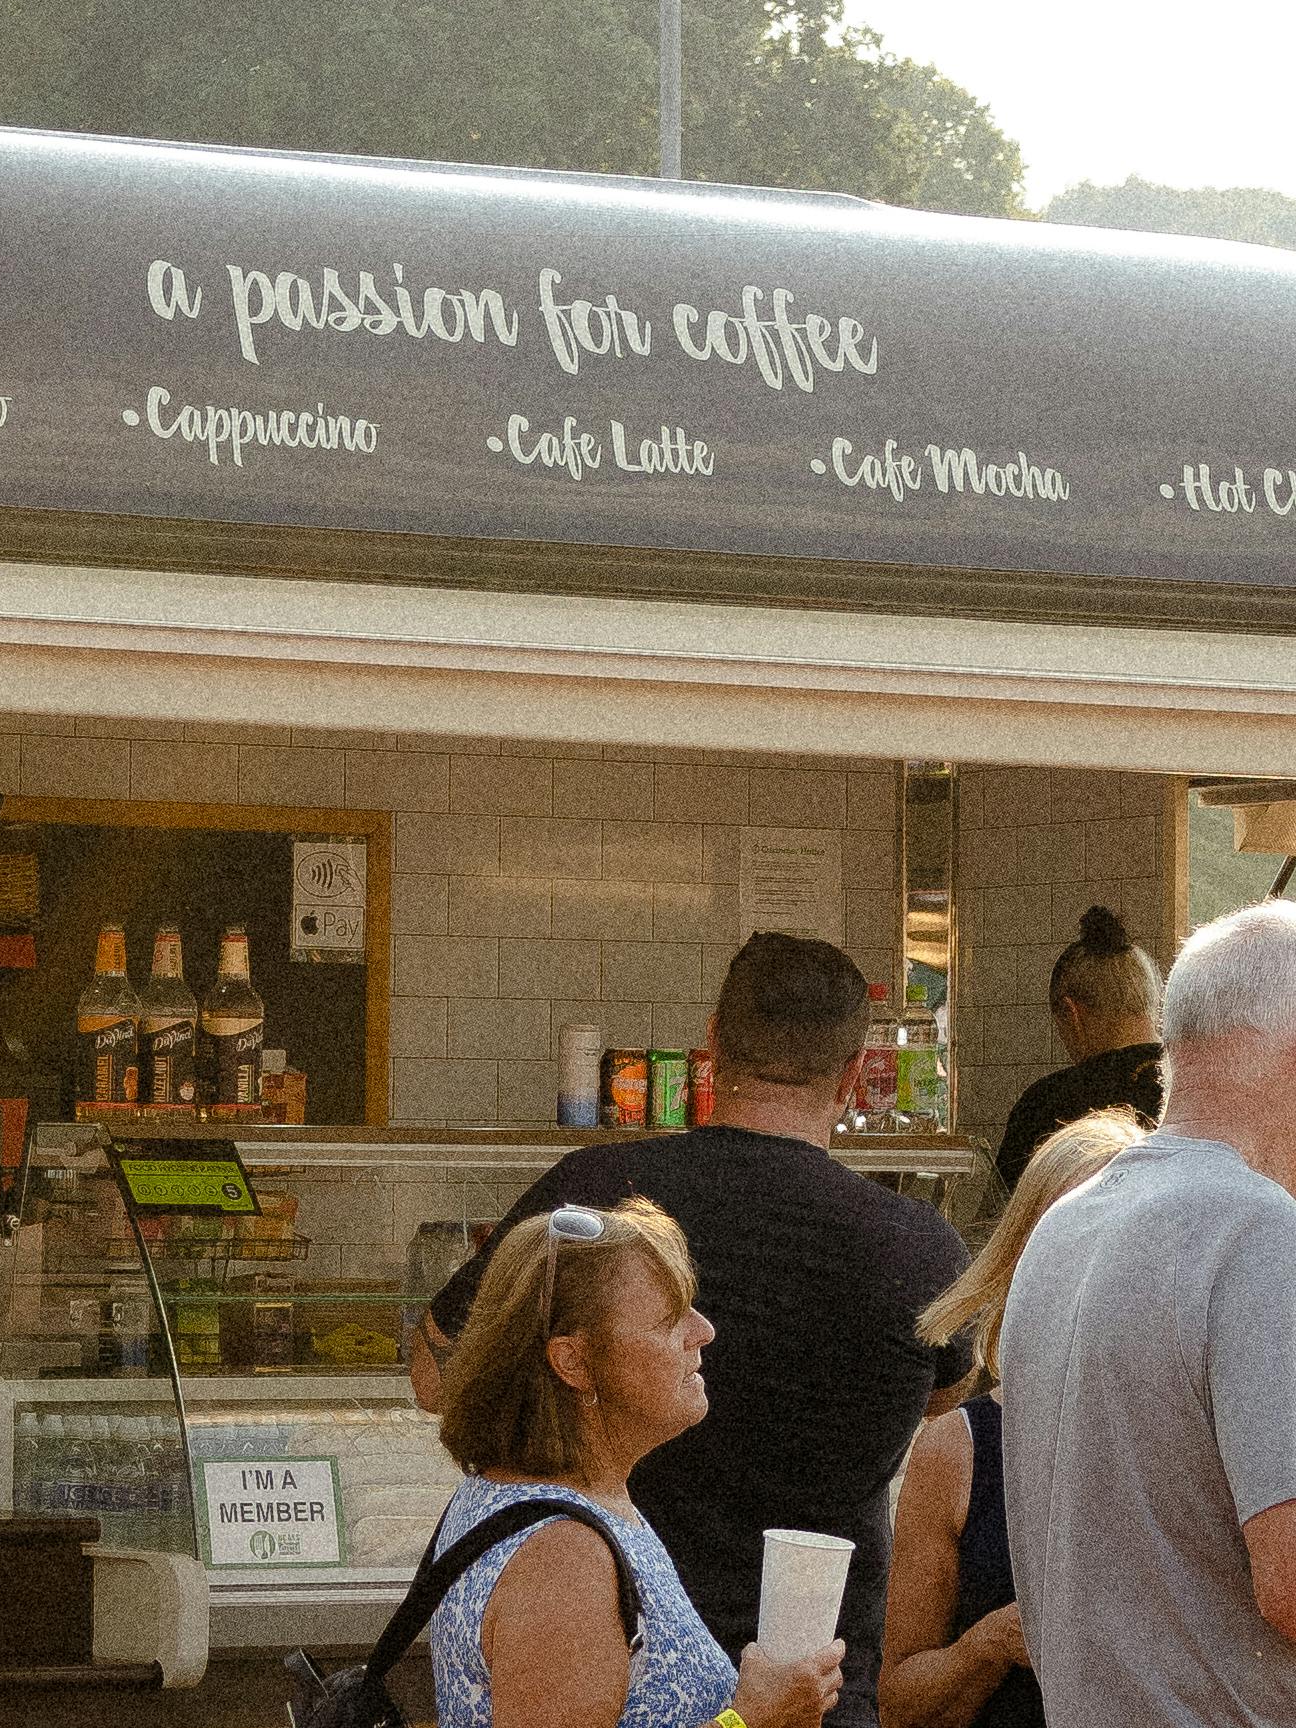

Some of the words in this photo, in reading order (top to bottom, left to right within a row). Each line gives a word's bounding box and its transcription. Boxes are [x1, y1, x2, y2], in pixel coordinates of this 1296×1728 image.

[147, 260, 201, 319] a
[228, 263, 518, 363] passion
[539, 267, 652, 373] for
[673, 285, 878, 391] coffee
[144, 386, 379, 466] Cappuccino
[505, 414, 601, 480] Cafe
[610, 420, 713, 475] Latte
[830, 437, 921, 501] Cafe
[924, 444, 1070, 502] Mocha
[1181, 462, 1254, 512] Hot
[322, 911, 359, 943] Pay
[96, 1054, 110, 1101] CARAMEL
[154, 1055, 167, 1103] HAZELNUT
[237, 1064, 249, 1103] VANILLA
[226, 1184, 239, 1198] 5
[240, 1469, 275, 1492] I'M
[281, 1469, 298, 1491] A
[219, 1500, 326, 1524] MEMBER
